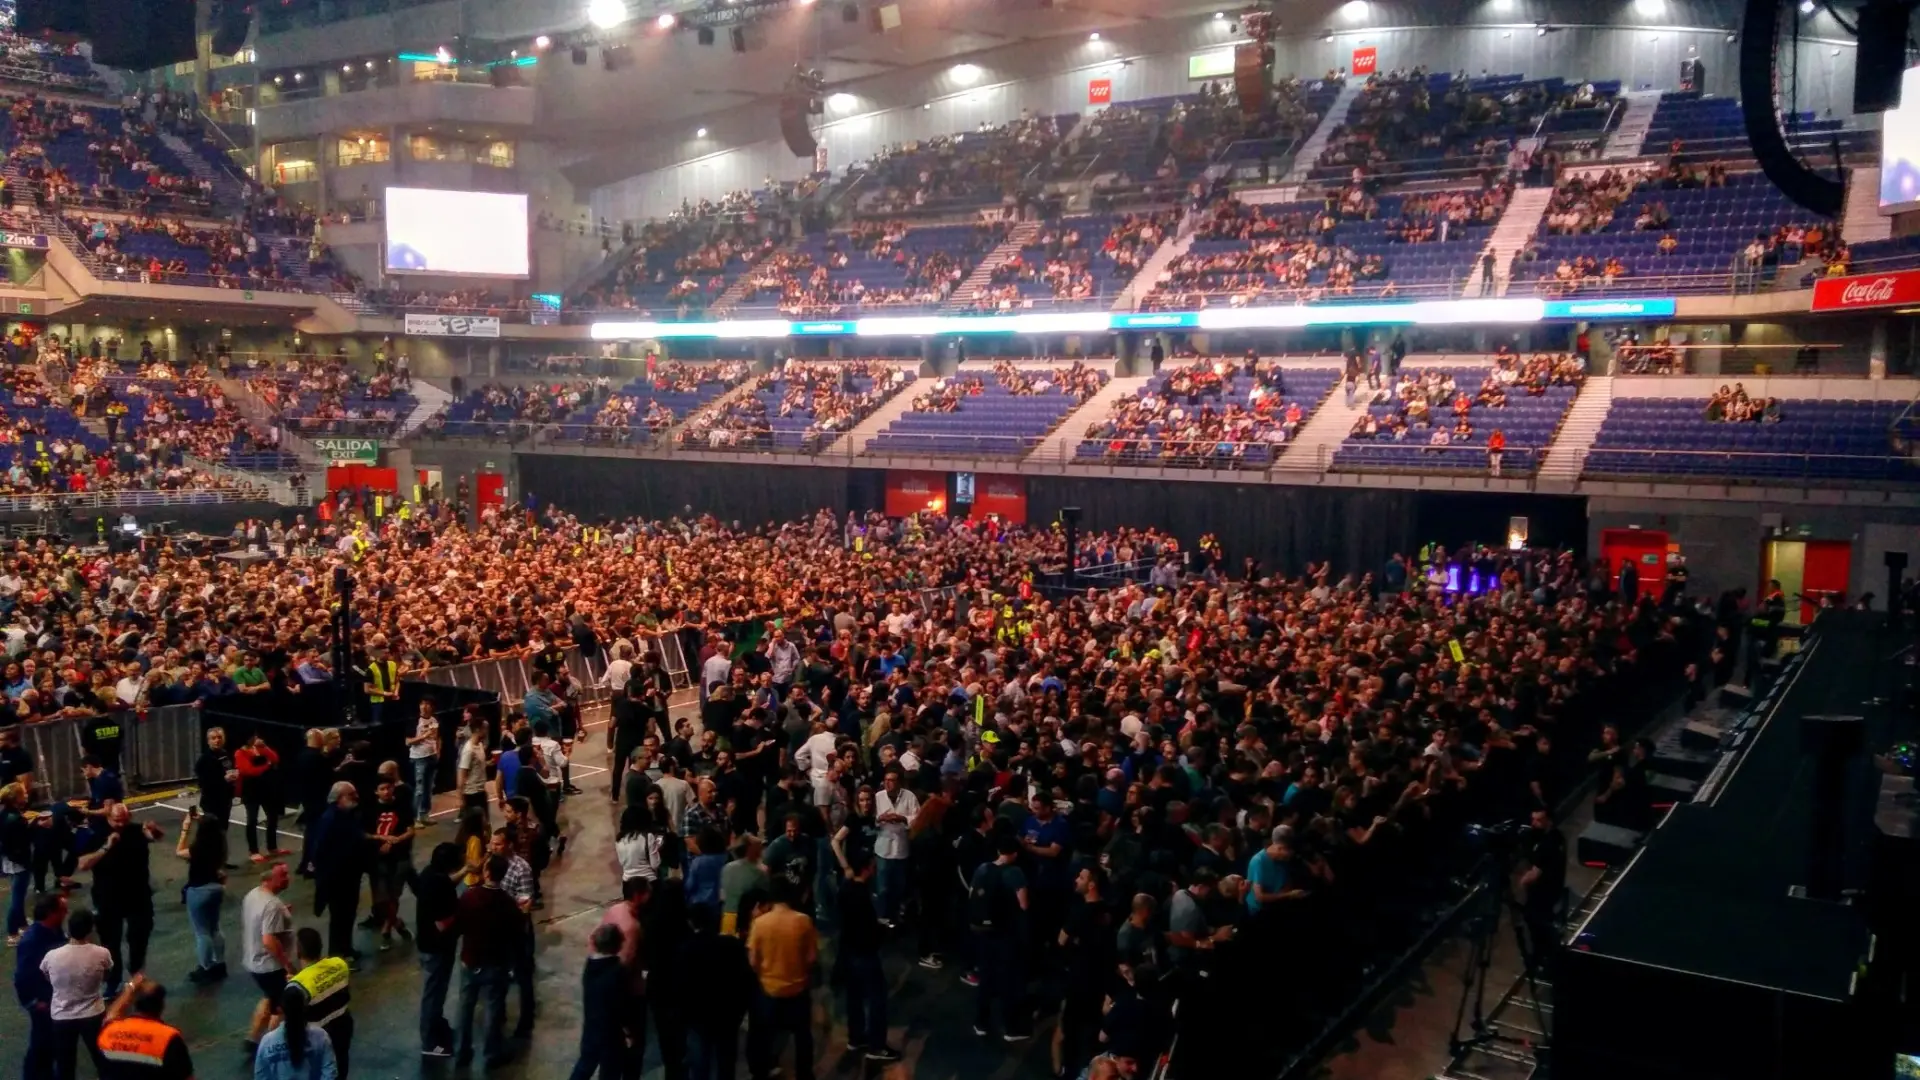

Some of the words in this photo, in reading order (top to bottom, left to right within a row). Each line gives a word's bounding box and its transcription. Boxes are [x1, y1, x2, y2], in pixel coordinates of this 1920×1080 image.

[315, 440, 372, 450] SALIDA
[331, 451, 357, 459] EXIT
[95, 726, 119, 737] STAFF
